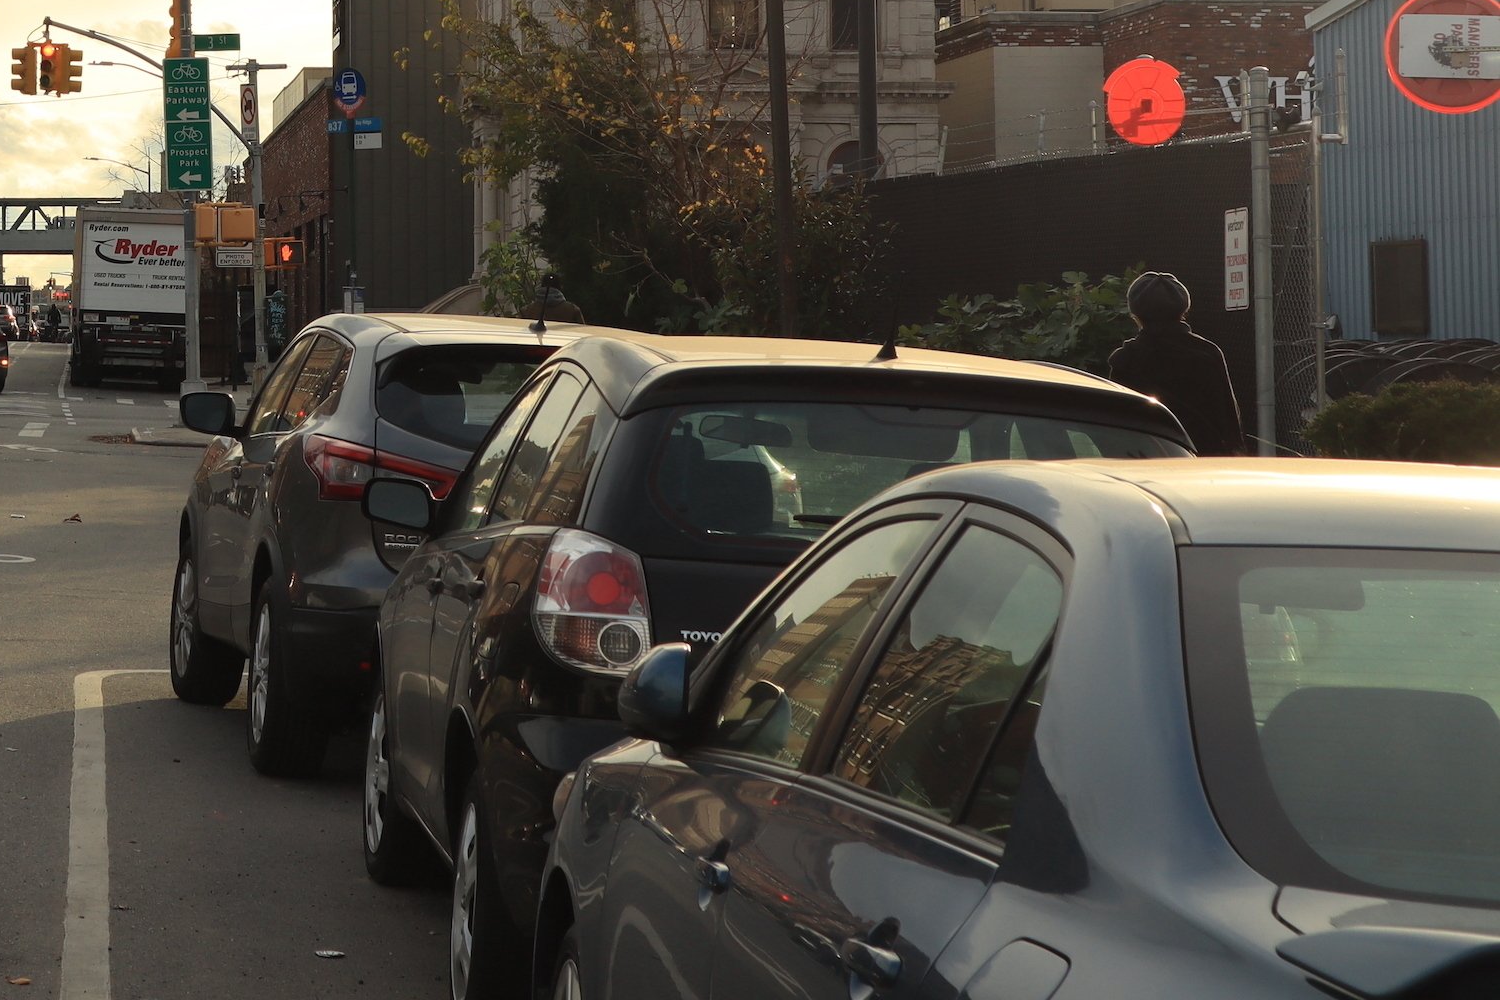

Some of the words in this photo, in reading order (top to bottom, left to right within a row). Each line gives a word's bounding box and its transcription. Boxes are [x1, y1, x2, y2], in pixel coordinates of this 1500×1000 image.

[207, 36, 214, 49] 3
[168, 85, 206, 94] Eastern
[166, 97, 207, 106] Parkway
[170, 148, 208, 158] Prospect
[89, 224, 129, 232] Ryder.com
[114, 239, 179, 259] Ryder
[138, 257, 158, 265] Ever
[680, 630, 724, 643] TOYO
